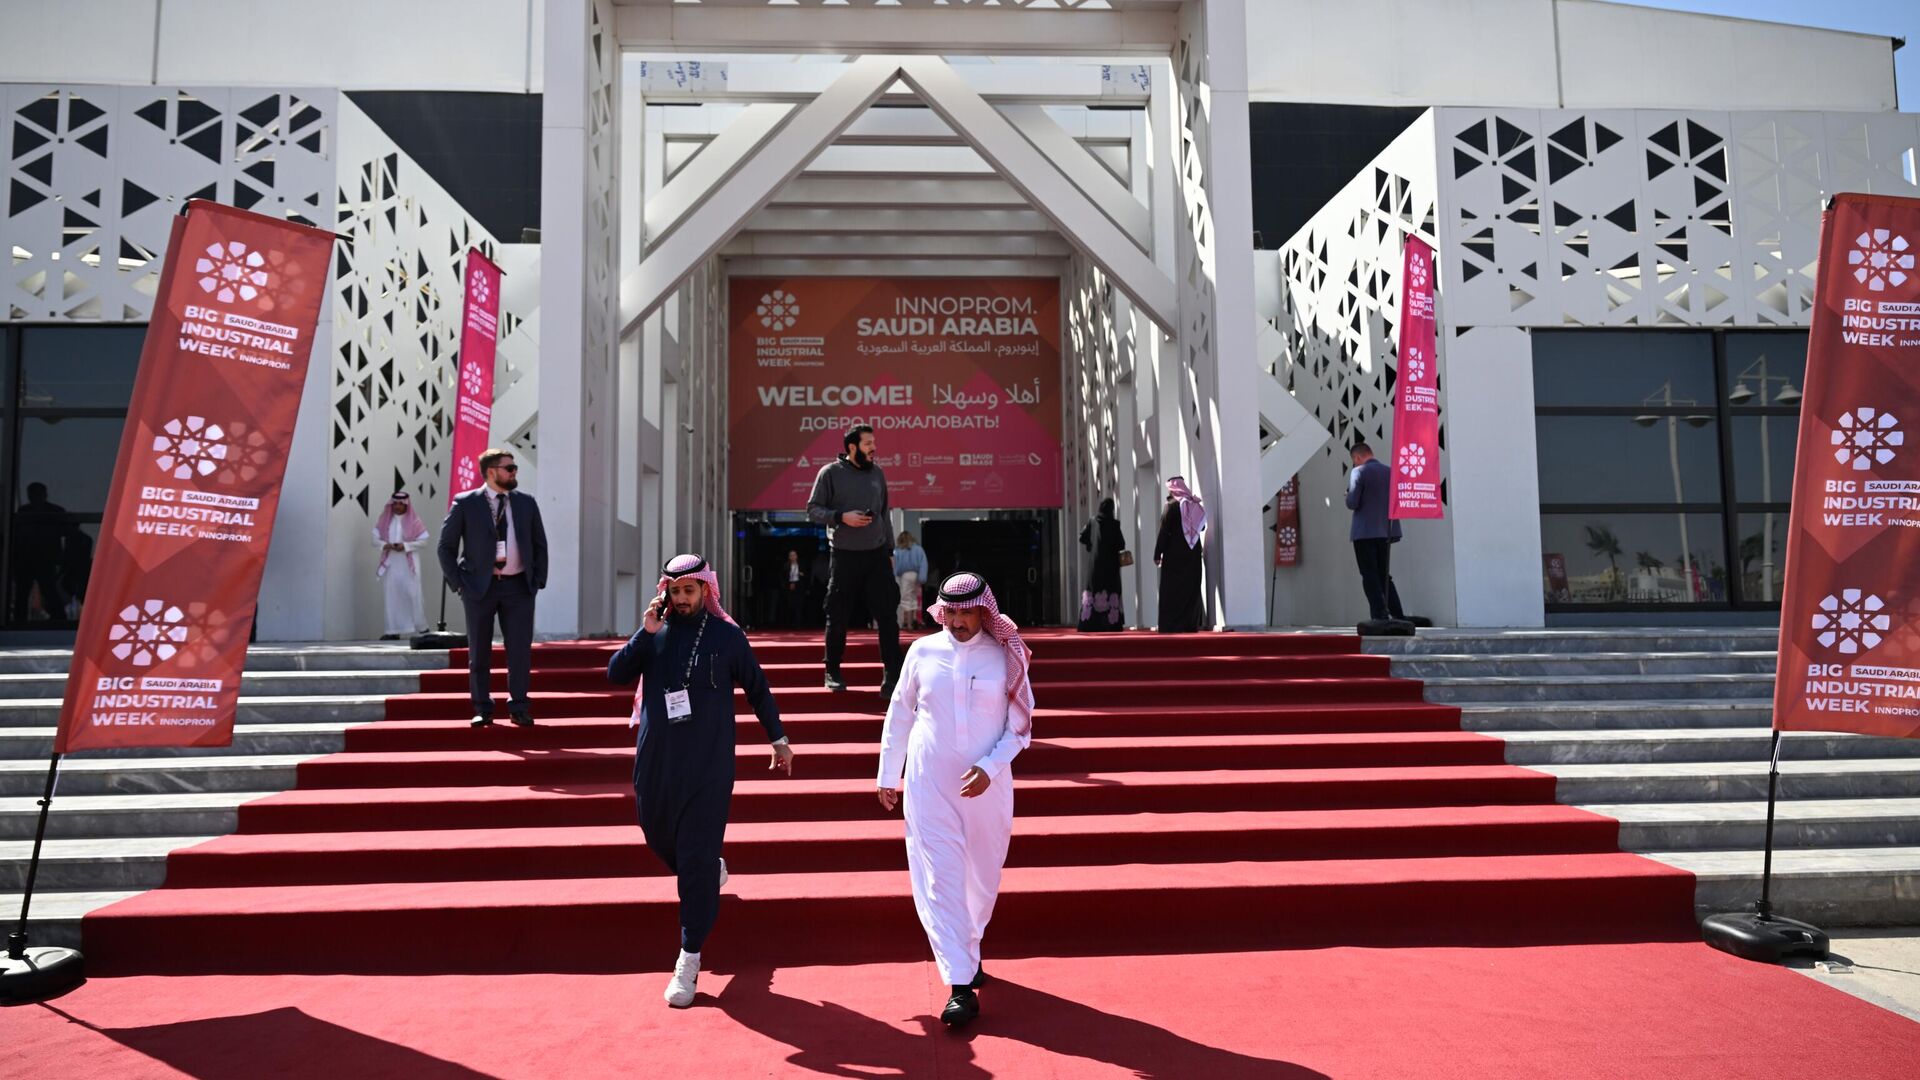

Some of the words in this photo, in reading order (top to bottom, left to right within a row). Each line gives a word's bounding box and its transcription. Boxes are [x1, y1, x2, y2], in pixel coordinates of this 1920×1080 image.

[896, 297, 1037, 315] INNOPROM.
[1844, 298, 1872, 312] BIG
[1882, 304, 1912, 312] SAUDI
[185, 305, 218, 322] BIG
[229, 316, 257, 328] SAUDI
[259, 323, 293, 336] ARABIA
[857, 317, 935, 336] SAUDI
[941, 317, 1039, 336] ARABIA
[1842, 315, 1920, 331] INDUSTR
[181, 322, 293, 354] INDUSTRIAL
[757, 337, 776, 346] BIG
[1842, 331, 1895, 347] WEEK
[179, 338, 237, 359] WEEK
[239, 354, 291, 370] INNOPROM
[757, 347, 824, 356] INDUSTRIAL
[857, 340, 908, 357] السعودية
[911, 340, 946, 355] العربية
[949, 340, 990, 353] المملكة
[757, 358, 791, 367] WEEK
[757, 385, 913, 406] WELCOME!
[1005, 377, 1040, 404] أهلا
[799, 416, 865, 432] ДОБРО
[869, 415, 1000, 429] ПОЖАЛОВАТЬ!
[1825, 480, 1856, 493] BIG
[141, 486, 175, 502] BIG
[186, 493, 216, 503] SAUDI
[218, 497, 254, 507] ARABIA
[1823, 497, 1920, 510] INDUSTRI
[137, 503, 254, 526] INDUSTRIAL
[1823, 513, 1883, 526] WEEK
[136, 520, 196, 537] WEEK
[198, 531, 252, 543] INNOPROM
[1807, 664, 1843, 677] BIG
[1855, 668, 1887, 676] SAUDI
[1889, 670, 1920, 679] ARABI
[97, 677, 135, 691] BIG
[146, 680, 177, 688] SAUDI
[179, 681, 217, 689] ARABIA
[93, 694, 218, 709] INDUSTRIAL
[1805, 698, 1870, 713] WEEK
[1874, 706, 1920, 716] INNOPRO
[92, 712, 158, 726] WEEK
[159, 718, 216, 726] INNOPROM
